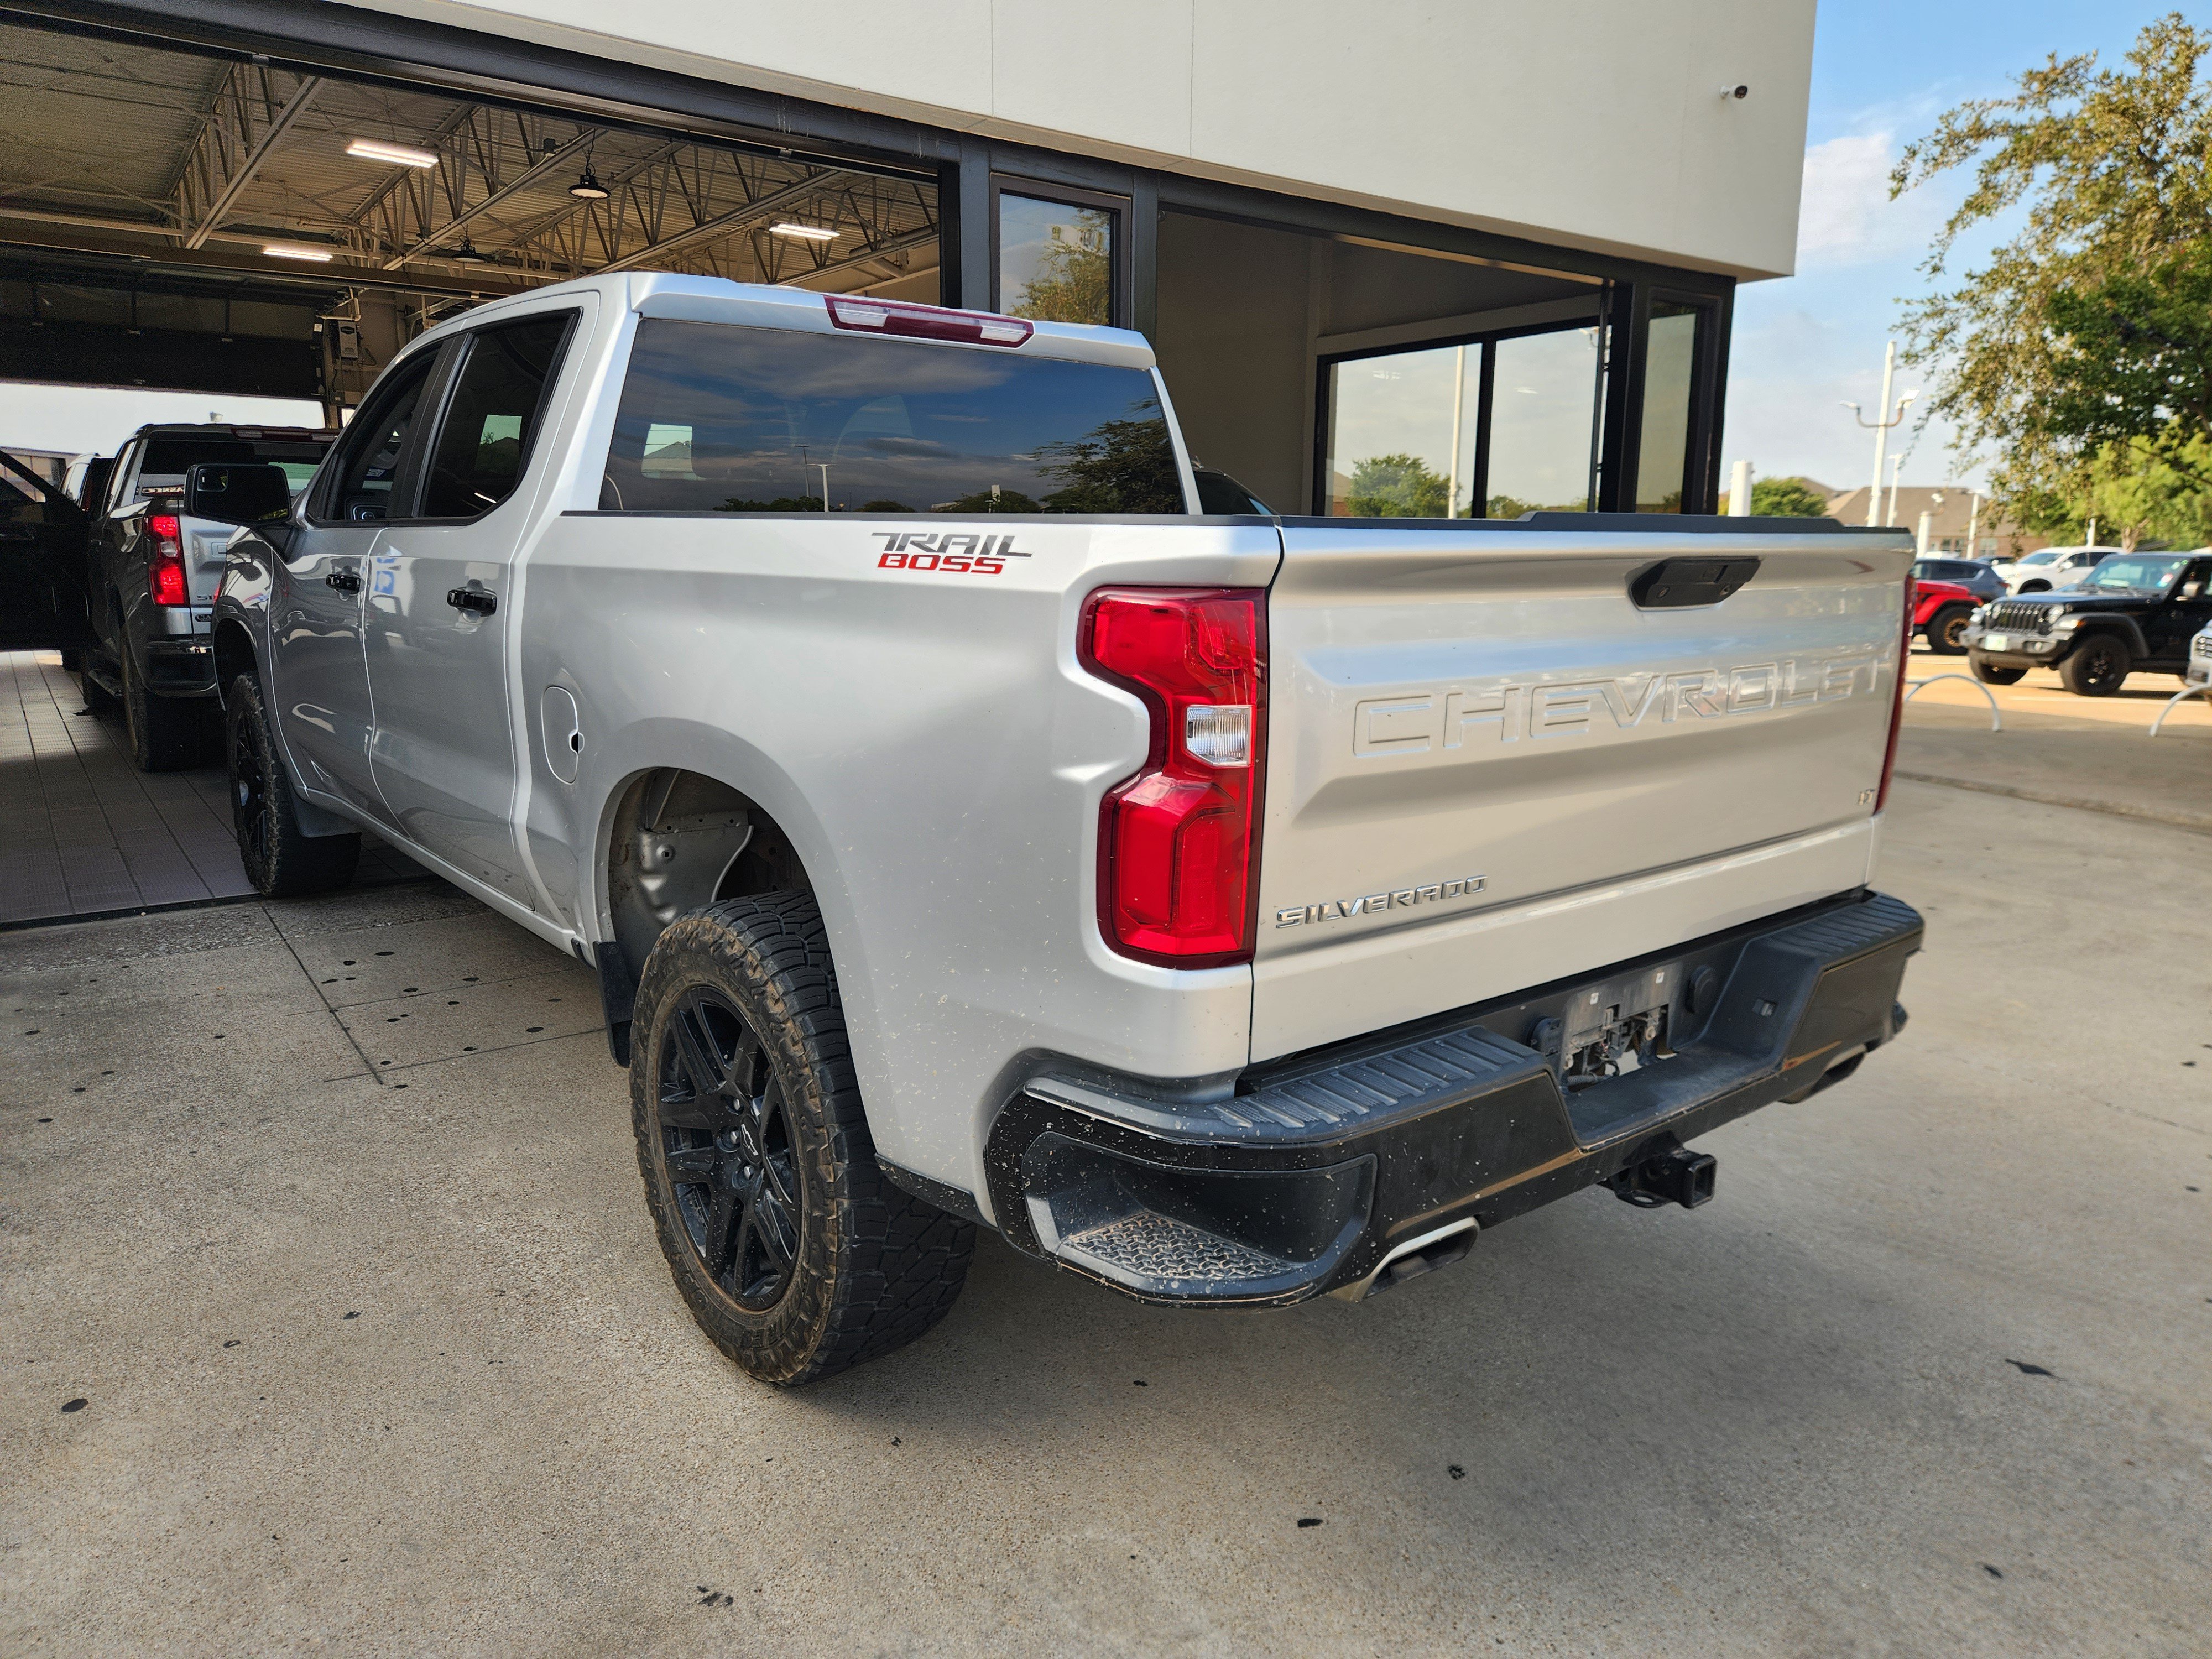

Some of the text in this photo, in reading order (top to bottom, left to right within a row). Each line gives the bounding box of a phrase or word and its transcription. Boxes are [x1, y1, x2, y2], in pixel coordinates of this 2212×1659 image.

[871, 532, 1033, 557] TRAIL
[877, 553, 1006, 574] BOSS
[1353, 649, 1890, 758] CHEVROLET
[1276, 874, 1488, 928] SILVERADO
